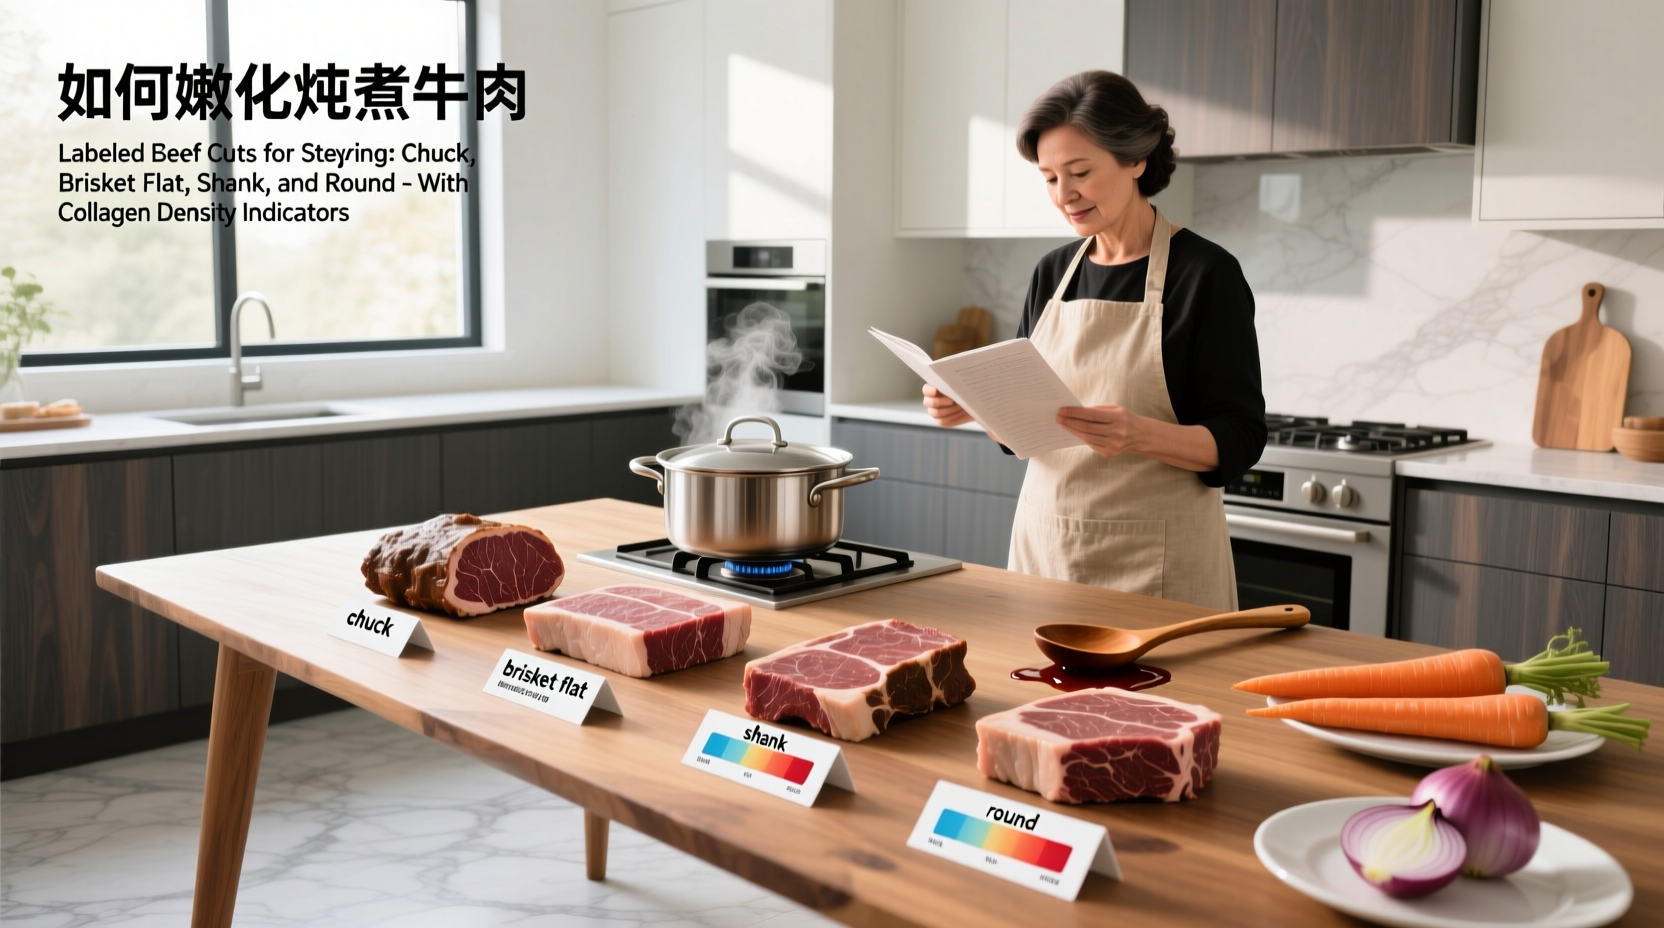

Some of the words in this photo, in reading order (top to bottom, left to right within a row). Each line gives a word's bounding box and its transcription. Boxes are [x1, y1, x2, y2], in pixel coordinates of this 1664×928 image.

[346, 608, 394, 638] chuck
[502, 658, 558, 691] brisket
[558, 676, 589, 700] flat
[743, 724, 789, 752] shank
[986, 805, 1041, 831] round
